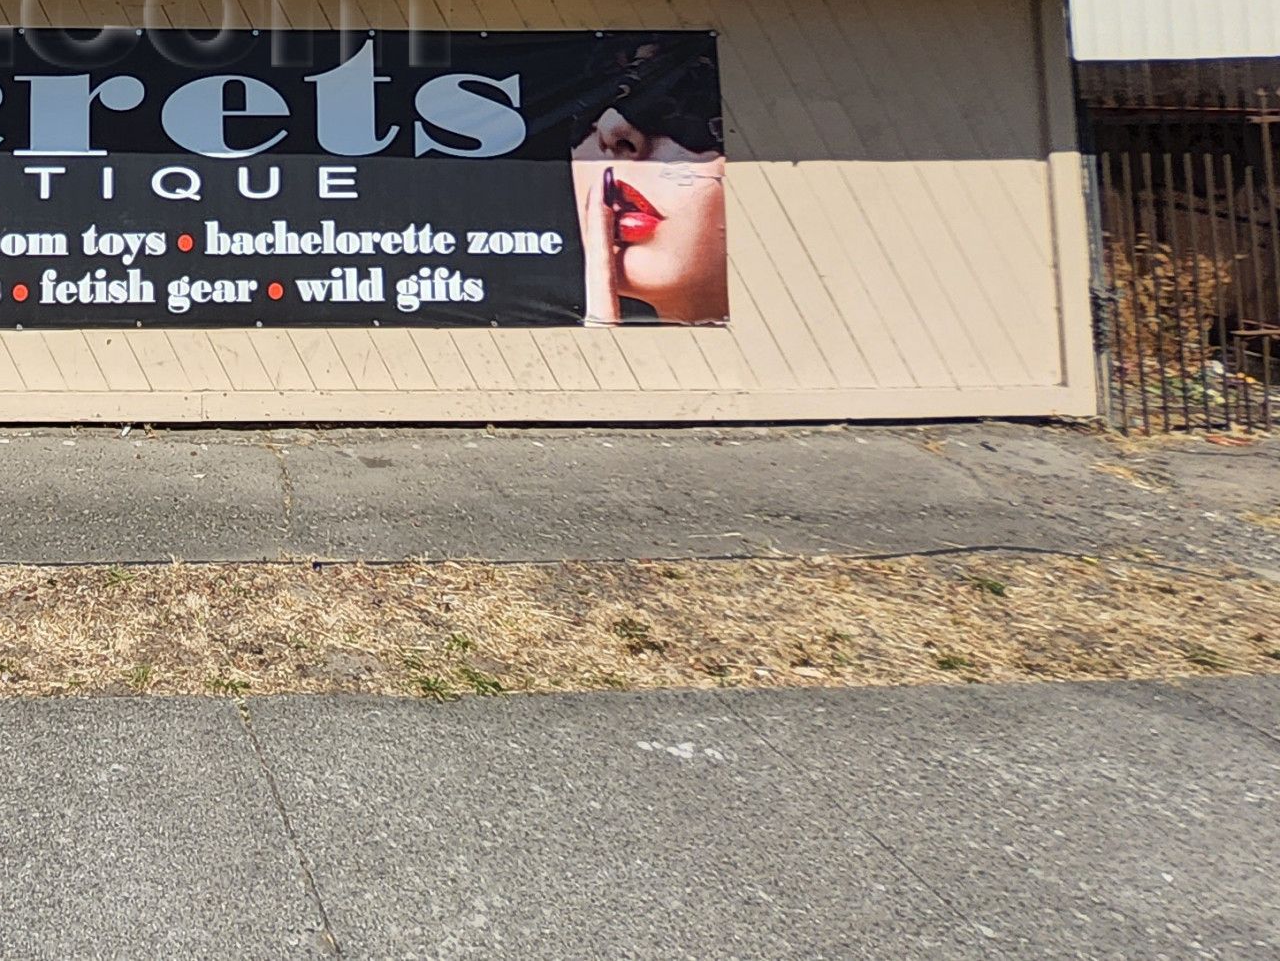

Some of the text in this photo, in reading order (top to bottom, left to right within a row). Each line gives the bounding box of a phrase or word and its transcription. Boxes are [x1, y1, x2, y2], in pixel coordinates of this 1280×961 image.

[81, 223, 168, 265] toys
[204, 221, 456, 256] bachelorette
[465, 231, 563, 255] zone
[39, 268, 156, 304] fetish
[166, 278, 258, 313] gear
[294, 267, 385, 303] wild
[395, 267, 485, 312] gifts
